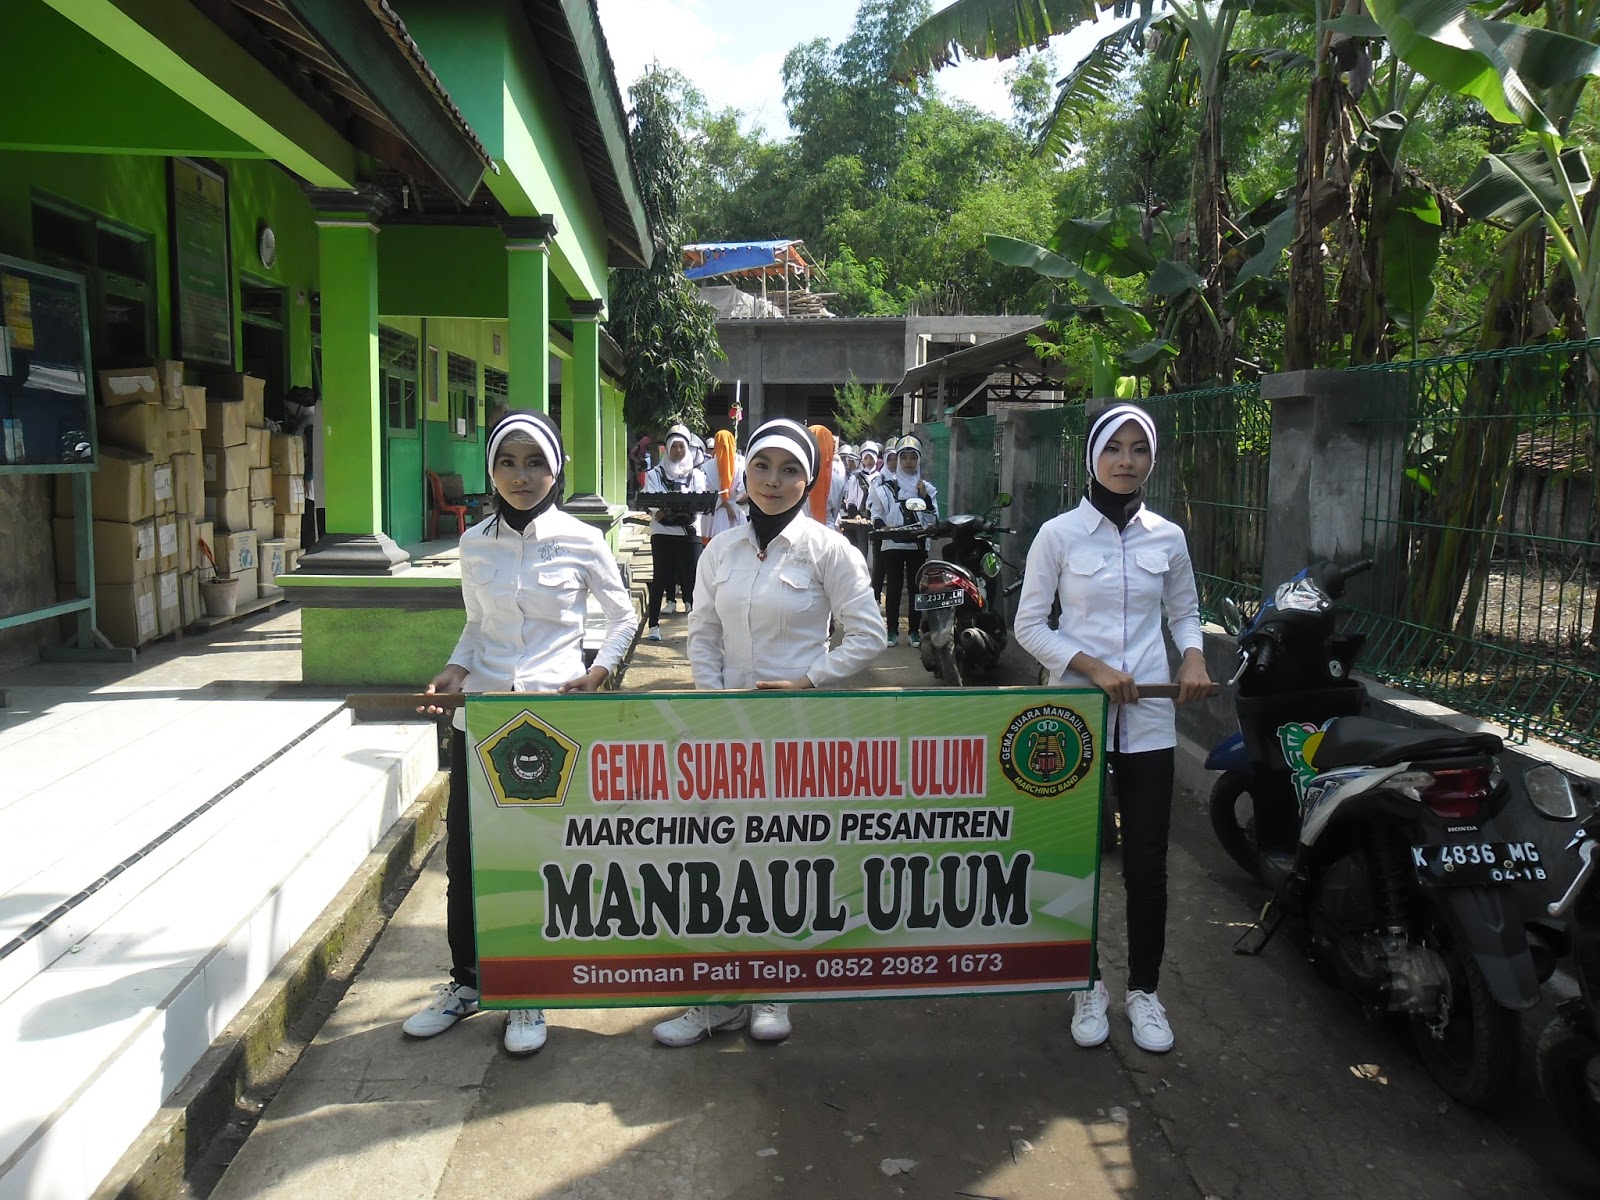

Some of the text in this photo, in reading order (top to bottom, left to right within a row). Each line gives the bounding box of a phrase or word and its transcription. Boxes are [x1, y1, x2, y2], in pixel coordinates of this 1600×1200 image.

[927, 593, 945, 602] 2337
[1001, 707, 1092, 760] GEMA SUARA MANBAUL ULUM
[591, 738, 984, 801] GEMA SUARA MANBAUL ULUM
[1014, 774, 1079, 794] MARCHING BAND
[565, 810, 1010, 846] MARCHING BAND PESANTREN
[1412, 842, 1540, 867] K 4836 MG
[543, 853, 1031, 938] MANBAUL ULUM
[572, 953, 1003, 984] Sinoman Pati Telp. 0852 2982 1673
